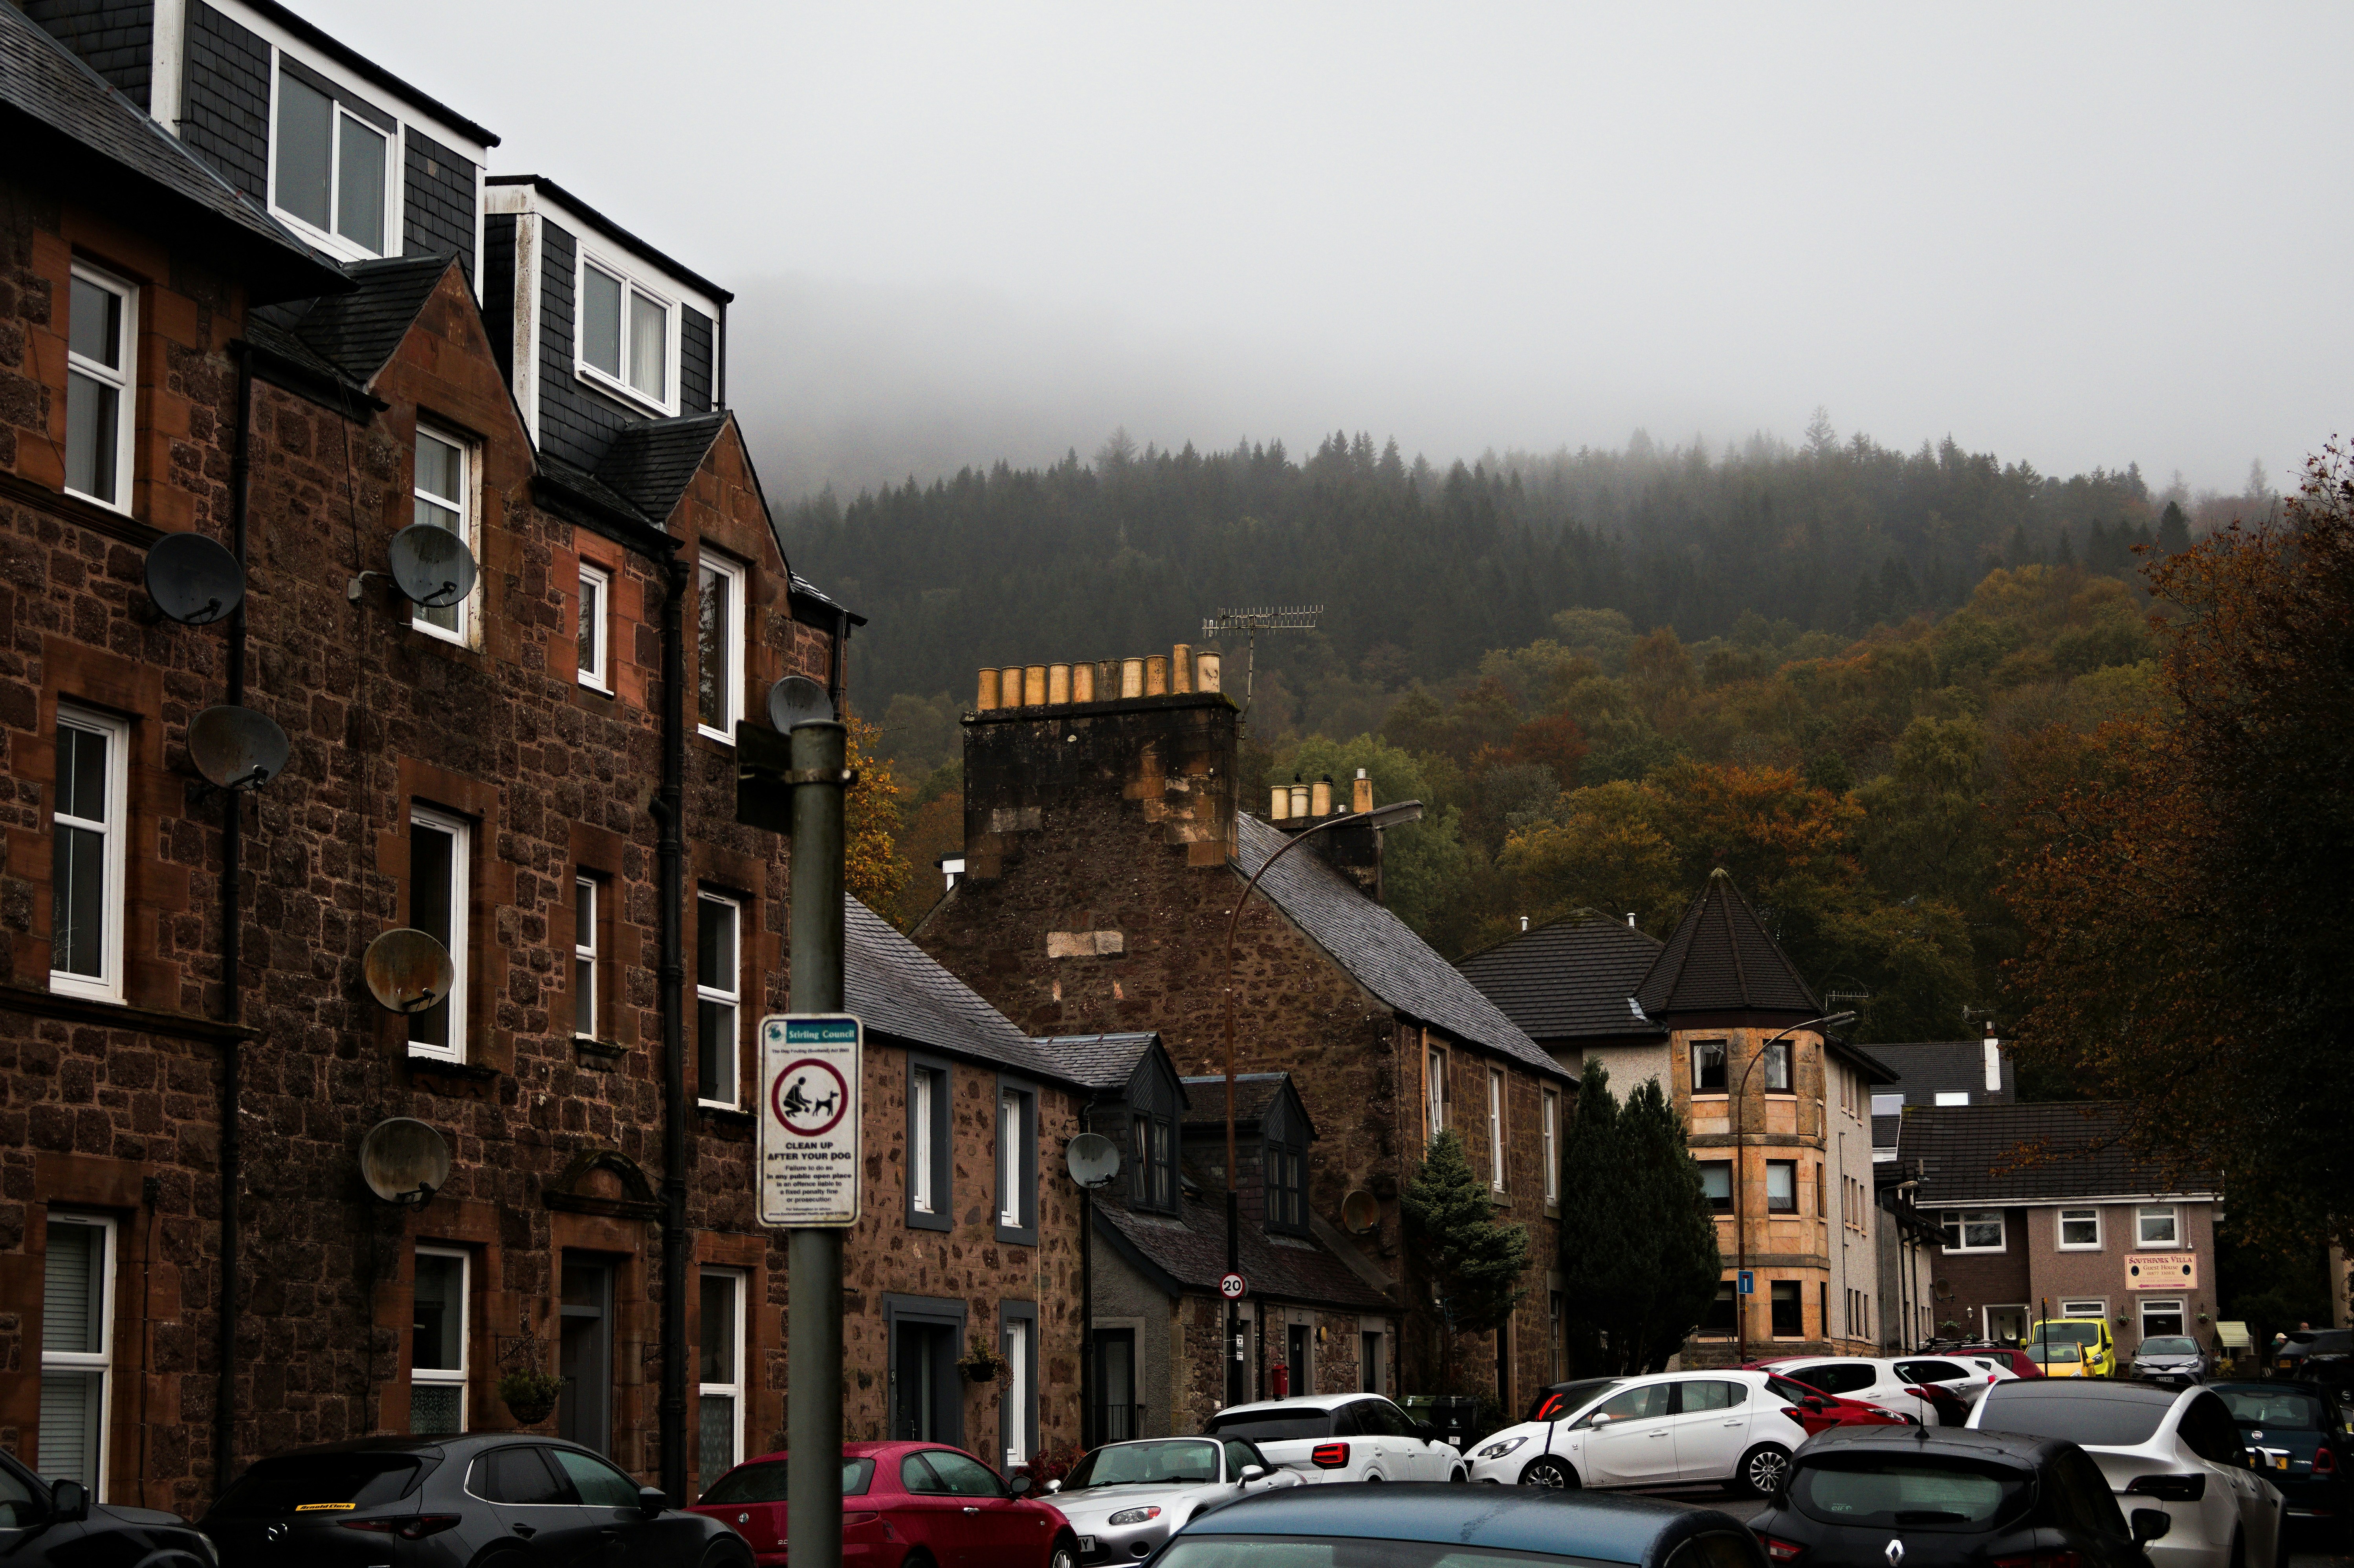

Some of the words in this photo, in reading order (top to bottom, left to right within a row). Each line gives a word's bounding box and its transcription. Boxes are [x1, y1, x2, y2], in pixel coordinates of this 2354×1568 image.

[789, 1030, 819, 1040] Stirling
[823, 1029, 854, 1038] Council
[1223, 1280, 1241, 1291] 20
[892, 1372, 895, 1382] 9
